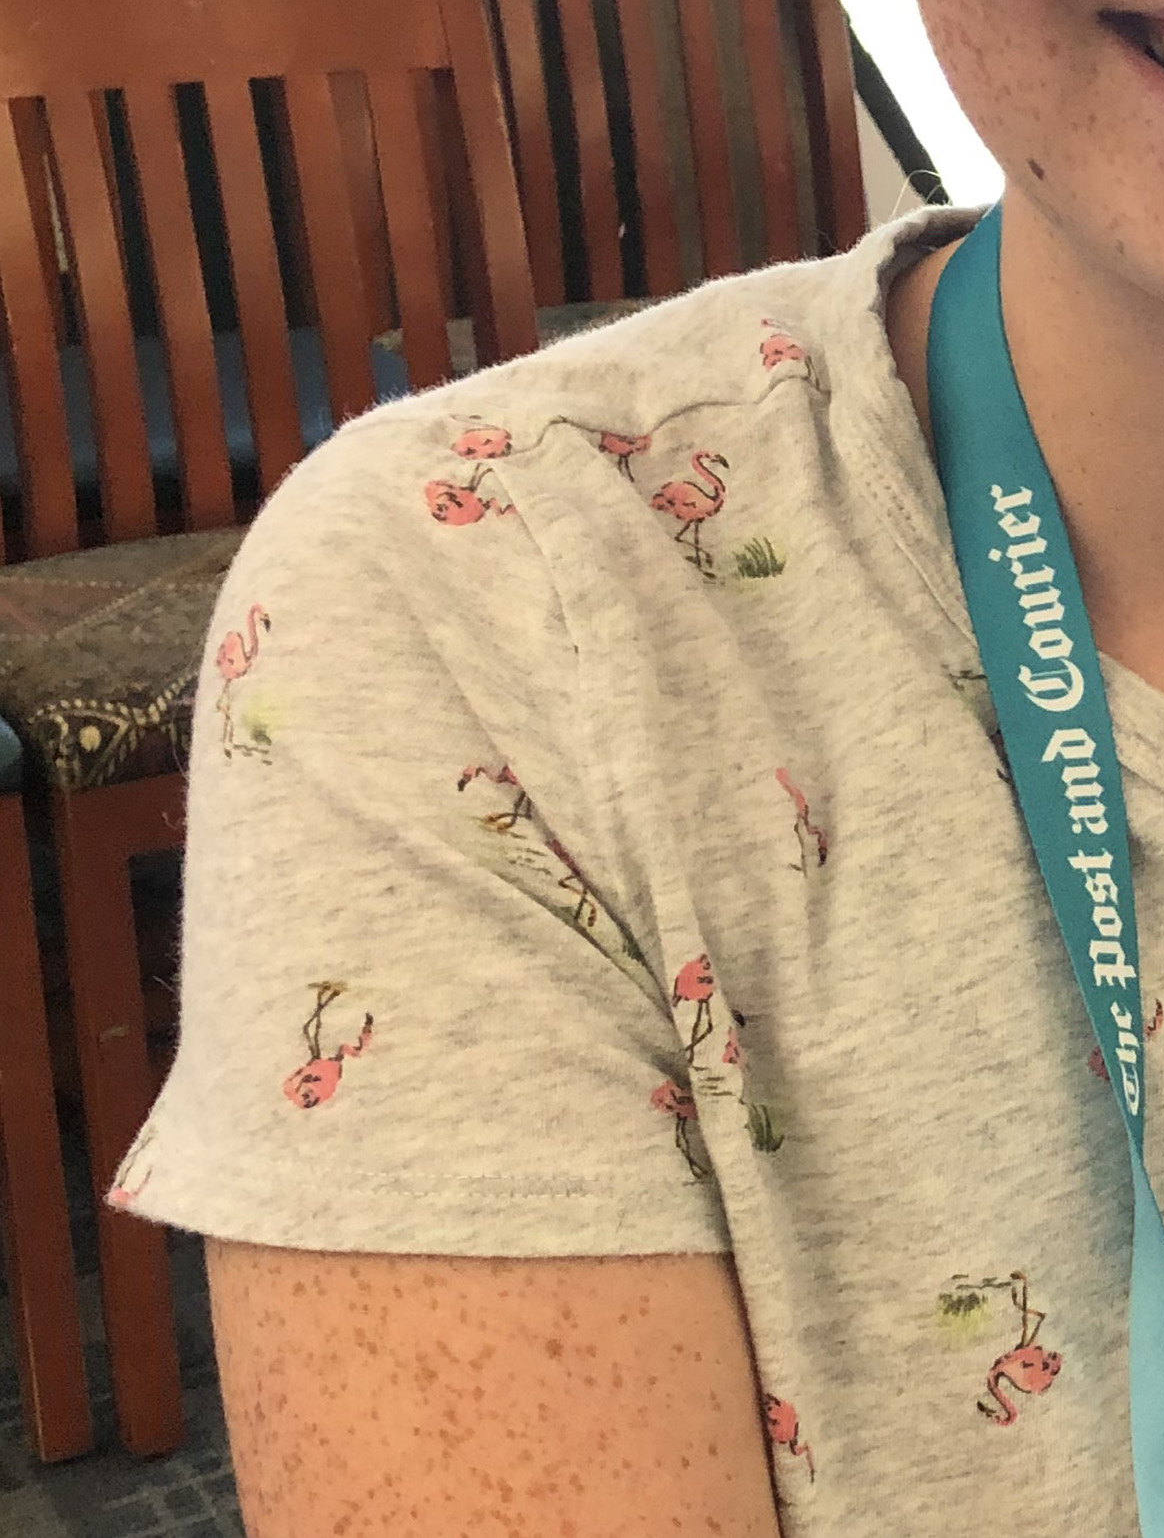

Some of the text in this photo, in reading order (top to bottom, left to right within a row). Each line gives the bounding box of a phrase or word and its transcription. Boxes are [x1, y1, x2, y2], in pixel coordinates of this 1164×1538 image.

[988, 484, 1084, 712] Courier
[1041, 728, 1108, 835] and
[1068, 848, 1137, 989] Post
